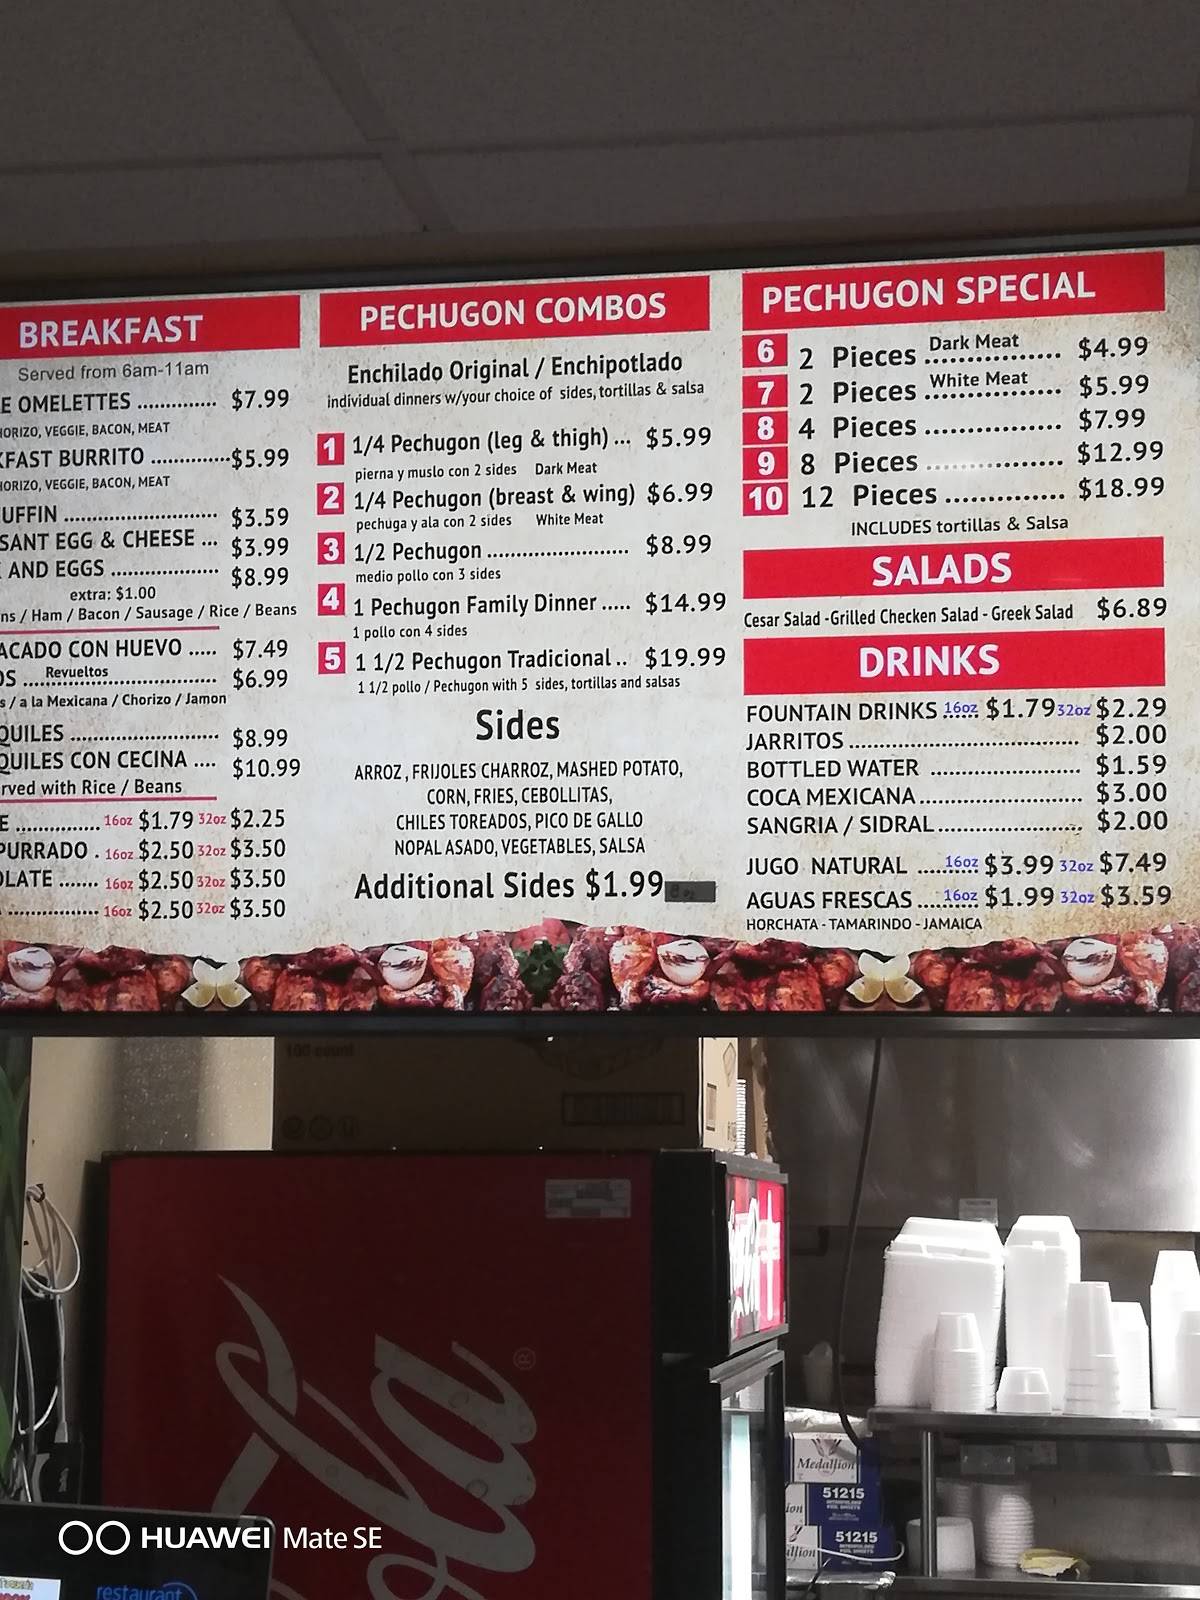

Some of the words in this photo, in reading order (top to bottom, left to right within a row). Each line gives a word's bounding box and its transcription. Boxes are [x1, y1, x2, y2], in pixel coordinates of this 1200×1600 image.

[762, 280, 945, 313] PECHUGON
[956, 272, 1096, 303] SPECIAL
[360, 300, 525, 331] PECHUGON
[536, 293, 666, 323] COMBOS
[19, 315, 203, 348] BREAKFAST
[930, 335, 969, 351] Dark
[976, 334, 1019, 348] Meat
[757, 339, 774, 363] 6
[800, 348, 813, 369] 2
[834, 346, 916, 368] Pieces
[1079, 337, 1147, 361] $4.99
[19, 366, 74, 381] Served
[81, 365, 116, 379] from
[123, 362, 208, 377] 6am-11am
[349, 362, 442, 383] Enchilado
[450, 358, 529, 383] Original
[552, 352, 682, 379] Enchipotlado
[328, 392, 390, 408] individual
[394, 393, 441, 405] dinners
[445, 391, 490, 406] w/your
[495, 388, 535, 401] choice
[540, 387, 552, 400] of
[560, 386, 596, 400] sides,
[599, 383, 651, 397] tortillas
[657, 382, 666, 395] &
[672, 381, 703, 394] salsa
[1080, 375, 1148, 399] $5.99
[19, 392, 130, 413] OMELETTES
[232, 389, 288, 411] $7.99
[45, 425, 88, 437] VEGGIE,
[92, 424, 134, 435] BACON,
[139, 422, 170, 433] MEAT
[322, 437, 336, 461] 1
[353, 435, 384, 456] 1/4
[392, 434, 479, 455] Pechugon
[488, 431, 522, 454] (leg
[531, 430, 544, 447] &
[553, 427, 608, 450] thigh)
[647, 427, 711, 450] $5.99
[60, 447, 143, 467] BURRITO
[232, 448, 288, 470] $5.99
[536, 463, 562, 475] Dark
[567, 462, 597, 473] Meat
[356, 468, 393, 483] pierna
[398, 470, 404, 481] y
[408, 466, 444, 478] muslo
[449, 468, 469, 476] con
[475, 464, 480, 476] 2
[486, 463, 516, 475] sides
[748, 486, 783, 511] 10
[803, 486, 833, 508] 12
[854, 484, 936, 506] Pieces
[1079, 477, 1164, 501] $18.99
[0, 505, 57, 524] UFFIN
[232, 507, 288, 529] $3.59
[852, 520, 931, 536] INCLUDES
[937, 518, 1000, 533] tortillas
[1007, 517, 1019, 530] &
[1027, 516, 1068, 530] Salsa
[56, 532, 92, 550] EGG
[101, 531, 115, 548] &
[123, 529, 194, 548] CHEESE
[232, 537, 288, 559] $3.99
[322, 538, 340, 562] 3
[355, 543, 384, 564] 1/2
[394, 542, 481, 563] Pechugon
[647, 534, 711, 557] $8.99
[356, 571, 392, 582] medio
[398, 569, 428, 584] pollo
[433, 572, 453, 580] con
[459, 568, 465, 580] 3
[470, 568, 500, 579] sides
[871, 553, 1013, 587] SALADS
[70, 590, 110, 601] extra:
[116, 586, 155, 601] $1.00
[745, 613, 779, 627] Cesar
[784, 611, 820, 626] Salad
[881, 609, 936, 624] Checken
[942, 607, 978, 622] Salad
[992, 605, 1031, 620] Greek
[1036, 604, 1072, 619] Salad
[1098, 597, 1166, 620] $6.89
[69, 640, 107, 658] CON
[116, 639, 181, 656] HUEVO
[233, 638, 287, 660] $7.49
[859, 644, 1000, 678] DRINKS
[46, 666, 108, 678] Revueltos
[233, 668, 287, 690] $6.99
[748, 704, 850, 722] FOUNTAIN
[859, 702, 937, 720] DRINKS
[945, 702, 978, 713] 16oz
[987, 697, 1055, 720] $1.79
[1058, 704, 1090, 716] 32oz
[1097, 697, 1166, 720] $2.29
[476, 709, 559, 740] Sides
[746, 732, 843, 750] JARRITOS
[1097, 723, 1166, 747] $2.00
[71, 752, 110, 769] CON
[118, 750, 187, 768] CECINA
[233, 757, 300, 780] $10.99
[413, 763, 476, 779] FRIJOLES
[482, 762, 552, 780] CHARROZ,
[558, 761, 617, 777] MASHED
[624, 760, 682, 777] POTATO,
[748, 761, 841, 778] BOTTLED
[847, 759, 919, 776] WATER
[1097, 753, 1166, 777] $1.59
[105, 815, 132, 825] 16oz
[140, 810, 193, 832] $1.79
[199, 813, 226, 824] 32oz
[231, 808, 284, 830] $2.25
[397, 815, 445, 830] CHILES
[450, 813, 531, 831] TOREADOS,
[536, 813, 568, 828] PICO
[574, 813, 591, 828] DE
[597, 812, 642, 827] GALLO
[748, 817, 838, 834] SANGRIA
[860, 816, 934, 833] SIDRAL
[1098, 808, 1167, 833] $2.00
[395, 840, 442, 855] NOPAL
[446, 839, 497, 857] ASADO,
[501, 838, 595, 856] VEGETABLES,
[600, 838, 645, 853] SALSA
[355, 873, 494, 899] Additional
[504, 872, 574, 898] Sides
[586, 868, 663, 900] $1.99
[747, 892, 815, 909] AGUAS
[823, 891, 912, 908] FRESCAS
[944, 889, 977, 901] 16oz
[985, 885, 1054, 909] $1.99
[1060, 891, 1094, 904] 32oz
[1101, 884, 1171, 908] $3.59
[747, 919, 818, 930] HORCHATA
[829, 918, 911, 929] TAMARINDO
[923, 918, 982, 929] JAMAICA
[797, 1458, 855, 1475] Medallion
[822, 1487, 865, 1499] 51215
[835, 1531, 878, 1543] 51215
